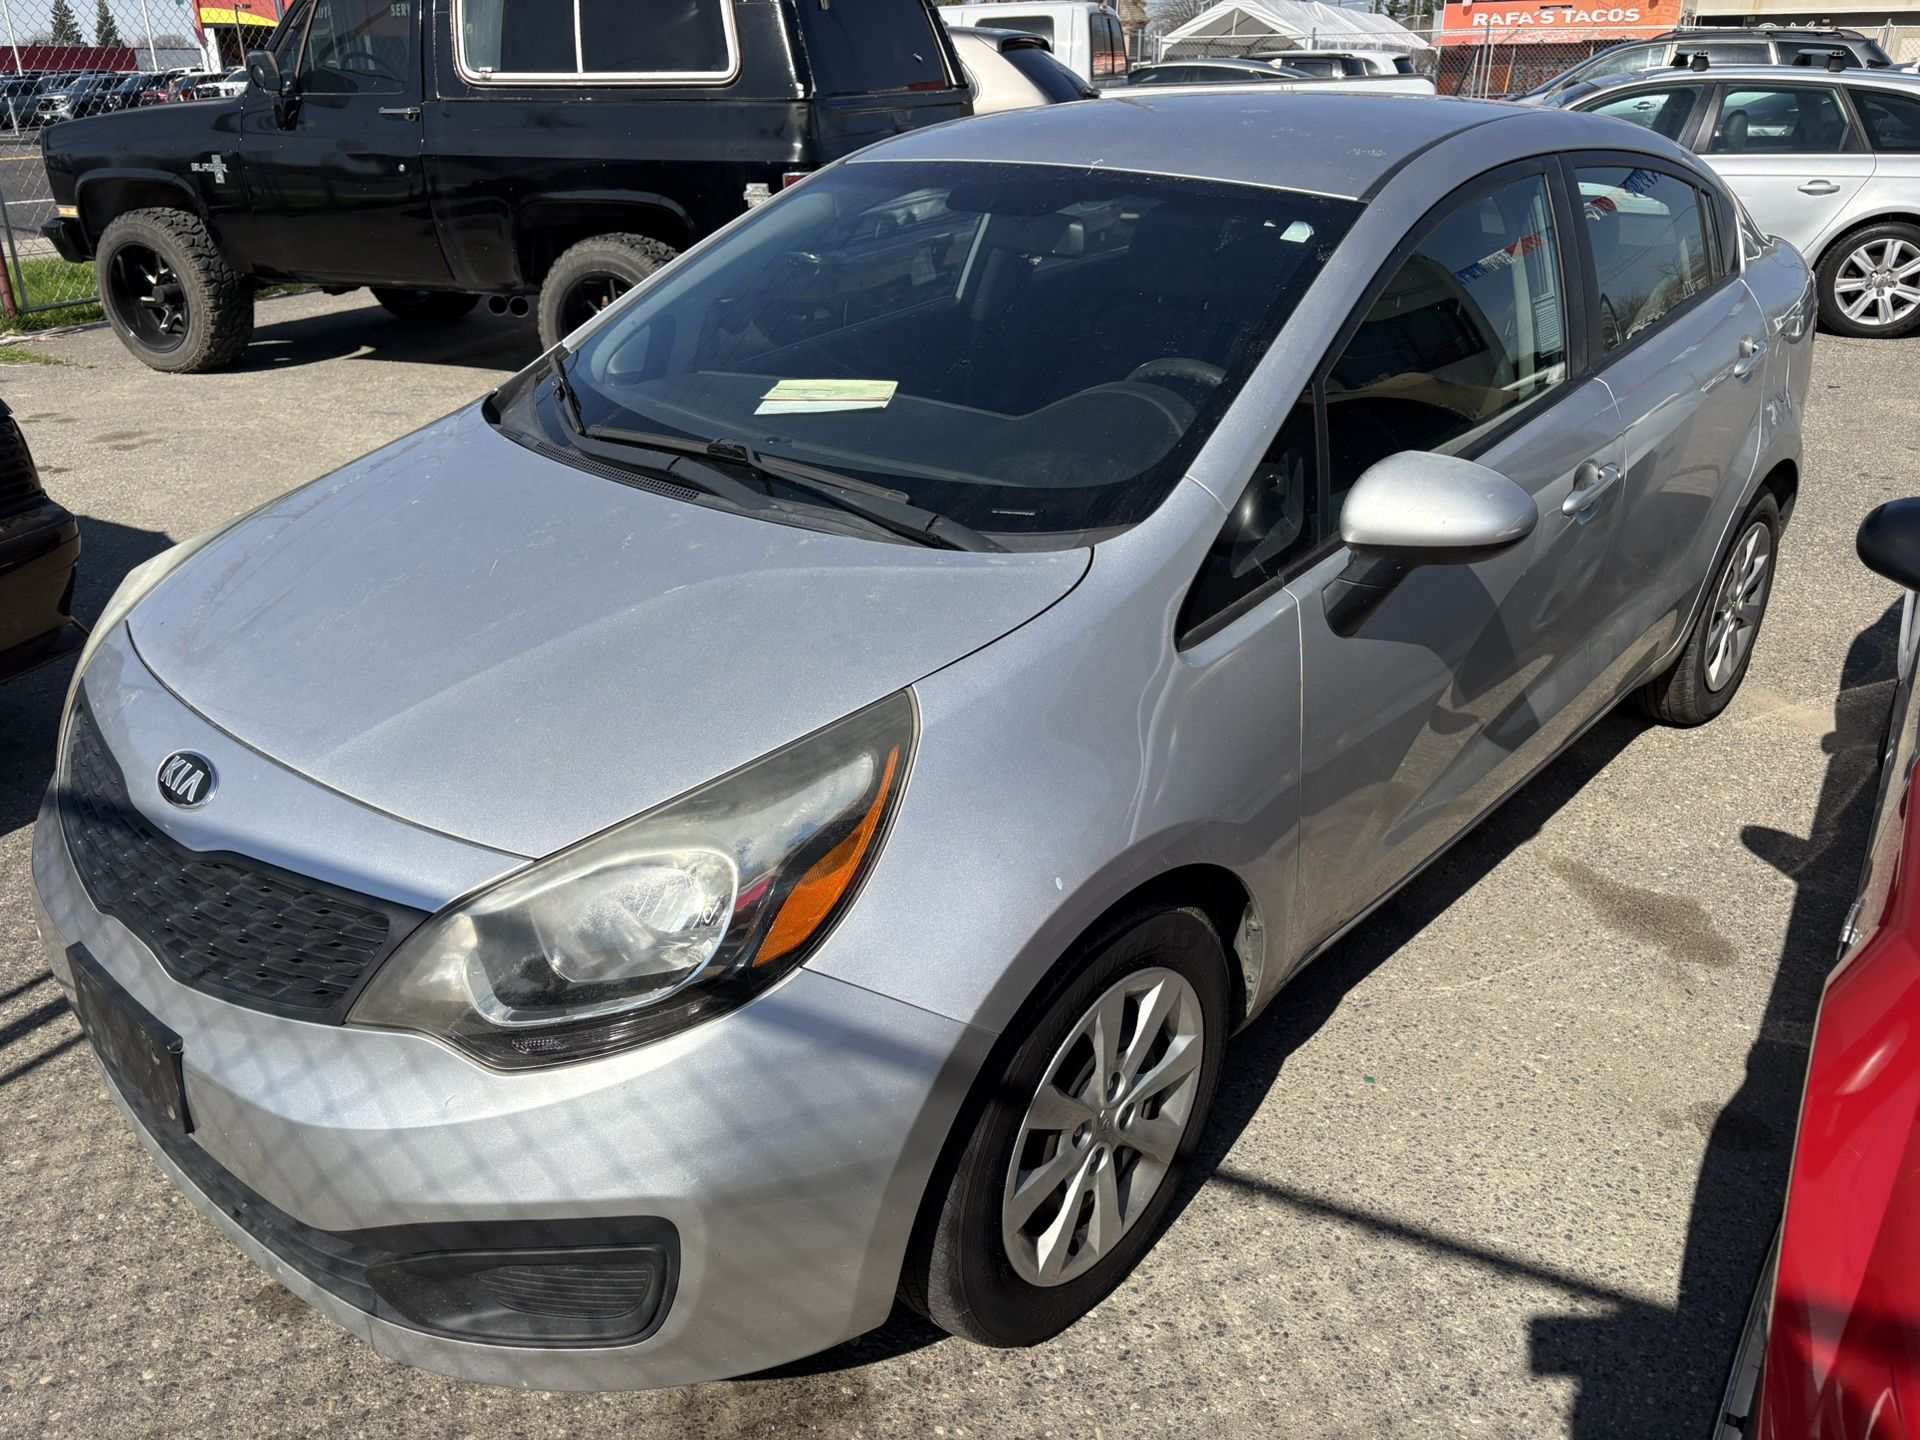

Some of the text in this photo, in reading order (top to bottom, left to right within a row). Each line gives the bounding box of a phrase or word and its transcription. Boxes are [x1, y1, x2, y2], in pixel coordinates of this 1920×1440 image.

[1472, 8, 1641, 27] RAFA'S TACOS
[160, 755, 205, 802] KIA
